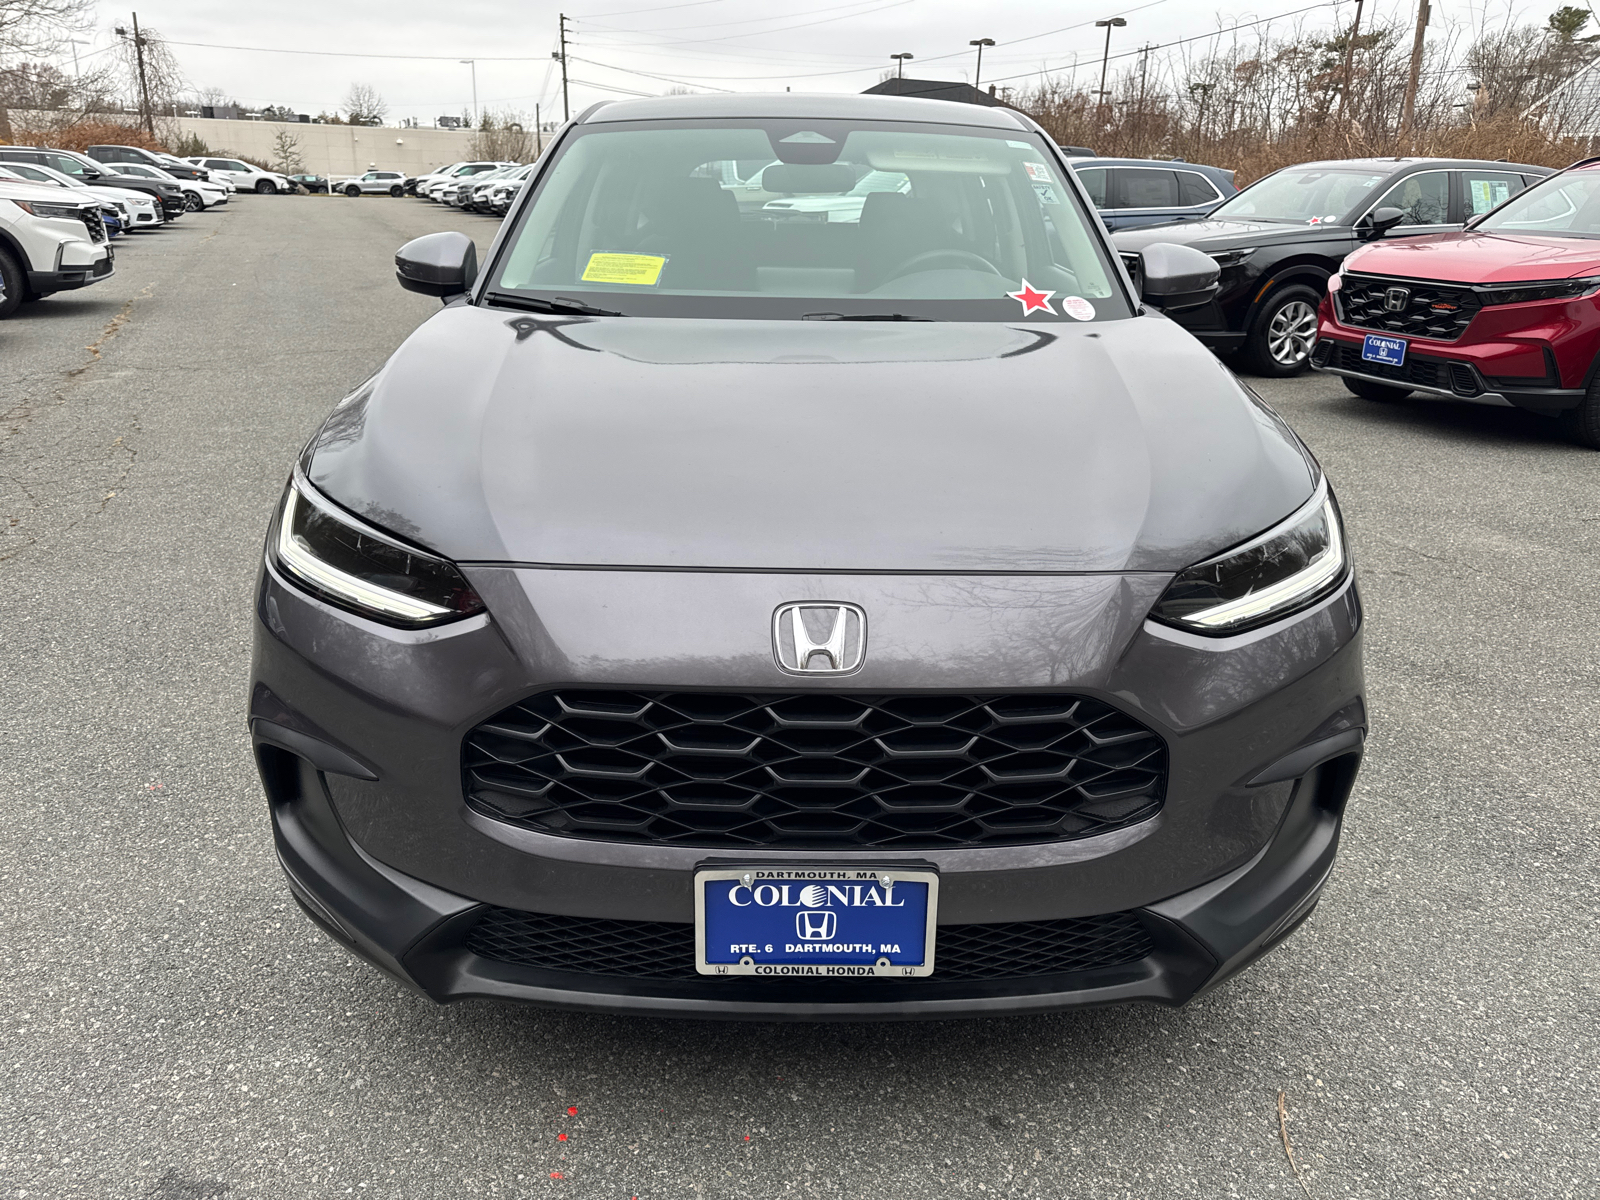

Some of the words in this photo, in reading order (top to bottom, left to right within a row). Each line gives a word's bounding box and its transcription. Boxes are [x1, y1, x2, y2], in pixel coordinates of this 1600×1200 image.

[1368, 338, 1401, 350] COLONIAL
[755, 871, 851, 879] DARTMOUTH,
[728, 884, 905, 908] COLONIAL
[730, 944, 761, 954] RTE.
[764, 944, 774, 953] 6
[785, 944, 876, 954] DARTMOUTH,
[880, 944, 901, 953] MA
[754, 965, 823, 976] COLONIAL
[826, 966, 875, 976] HONDA
